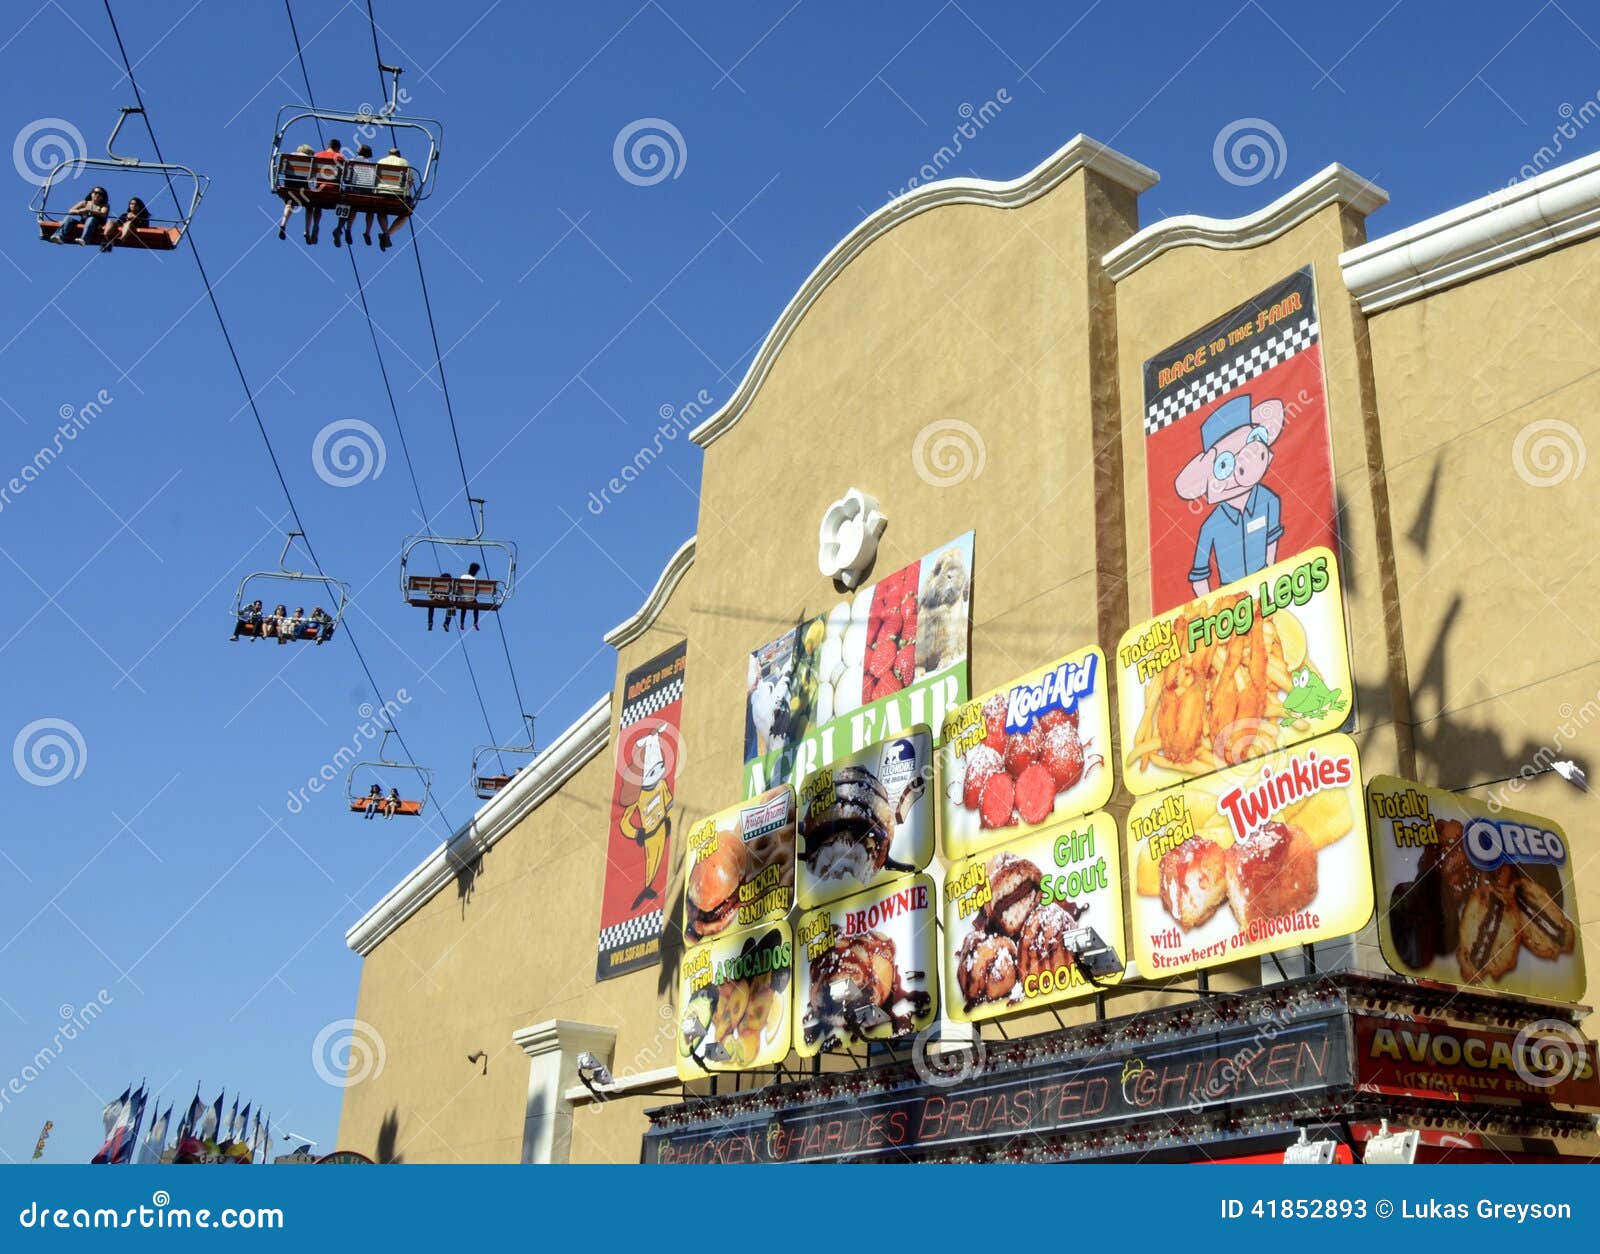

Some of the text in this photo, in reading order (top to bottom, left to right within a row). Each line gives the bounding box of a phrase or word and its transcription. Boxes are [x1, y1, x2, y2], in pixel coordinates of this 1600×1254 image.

[335, 206, 350, 217] 09
[1158, 292, 1303, 389] RACE TO THE FAIR
[1187, 556, 1329, 653] Frog Legs
[1120, 620, 1173, 668] Totally
[1136, 633, 1181, 684] Fried
[850, 674, 960, 754] FAIR
[1005, 653, 1097, 733] Kool-Aid
[944, 702, 983, 743] Totally
[954, 714, 989, 758] Fried
[801, 768, 833, 806] Totally
[809, 781, 837, 819] Fried
[1220, 751, 1352, 840] Twinkies
[1372, 789, 1430, 820] Totally
[688, 820, 717, 851] Totally
[1131, 795, 1186, 841] Totally
[1149, 810, 1195, 860] Fried
[1392, 814, 1441, 848] Fried
[696, 831, 719, 864] Fried
[1053, 824, 1095, 868] Girl
[1465, 818, 1566, 867] OREO
[738, 863, 781, 903] CHICKEN
[945, 861, 987, 902] Totally
[957, 876, 993, 920] Fried
[1039, 856, 1109, 907] Scout
[738, 886, 790, 925] SANDWICH
[846, 885, 929, 938] BROWNIE
[797, 911, 831, 947] Totally
[807, 926, 836, 962] Fried
[1150, 928, 1183, 950] with
[1152, 909, 1321, 969] Strawberry or Chocolate
[683, 949, 712, 979] Totally
[690, 960, 714, 993] Fried
[714, 942, 792, 986] AVOCADOS
[1024, 963, 1117, 998] COOK
[918, 1077, 1110, 1140] BROASTED
[1128, 1035, 1328, 1108] CHICKEN
